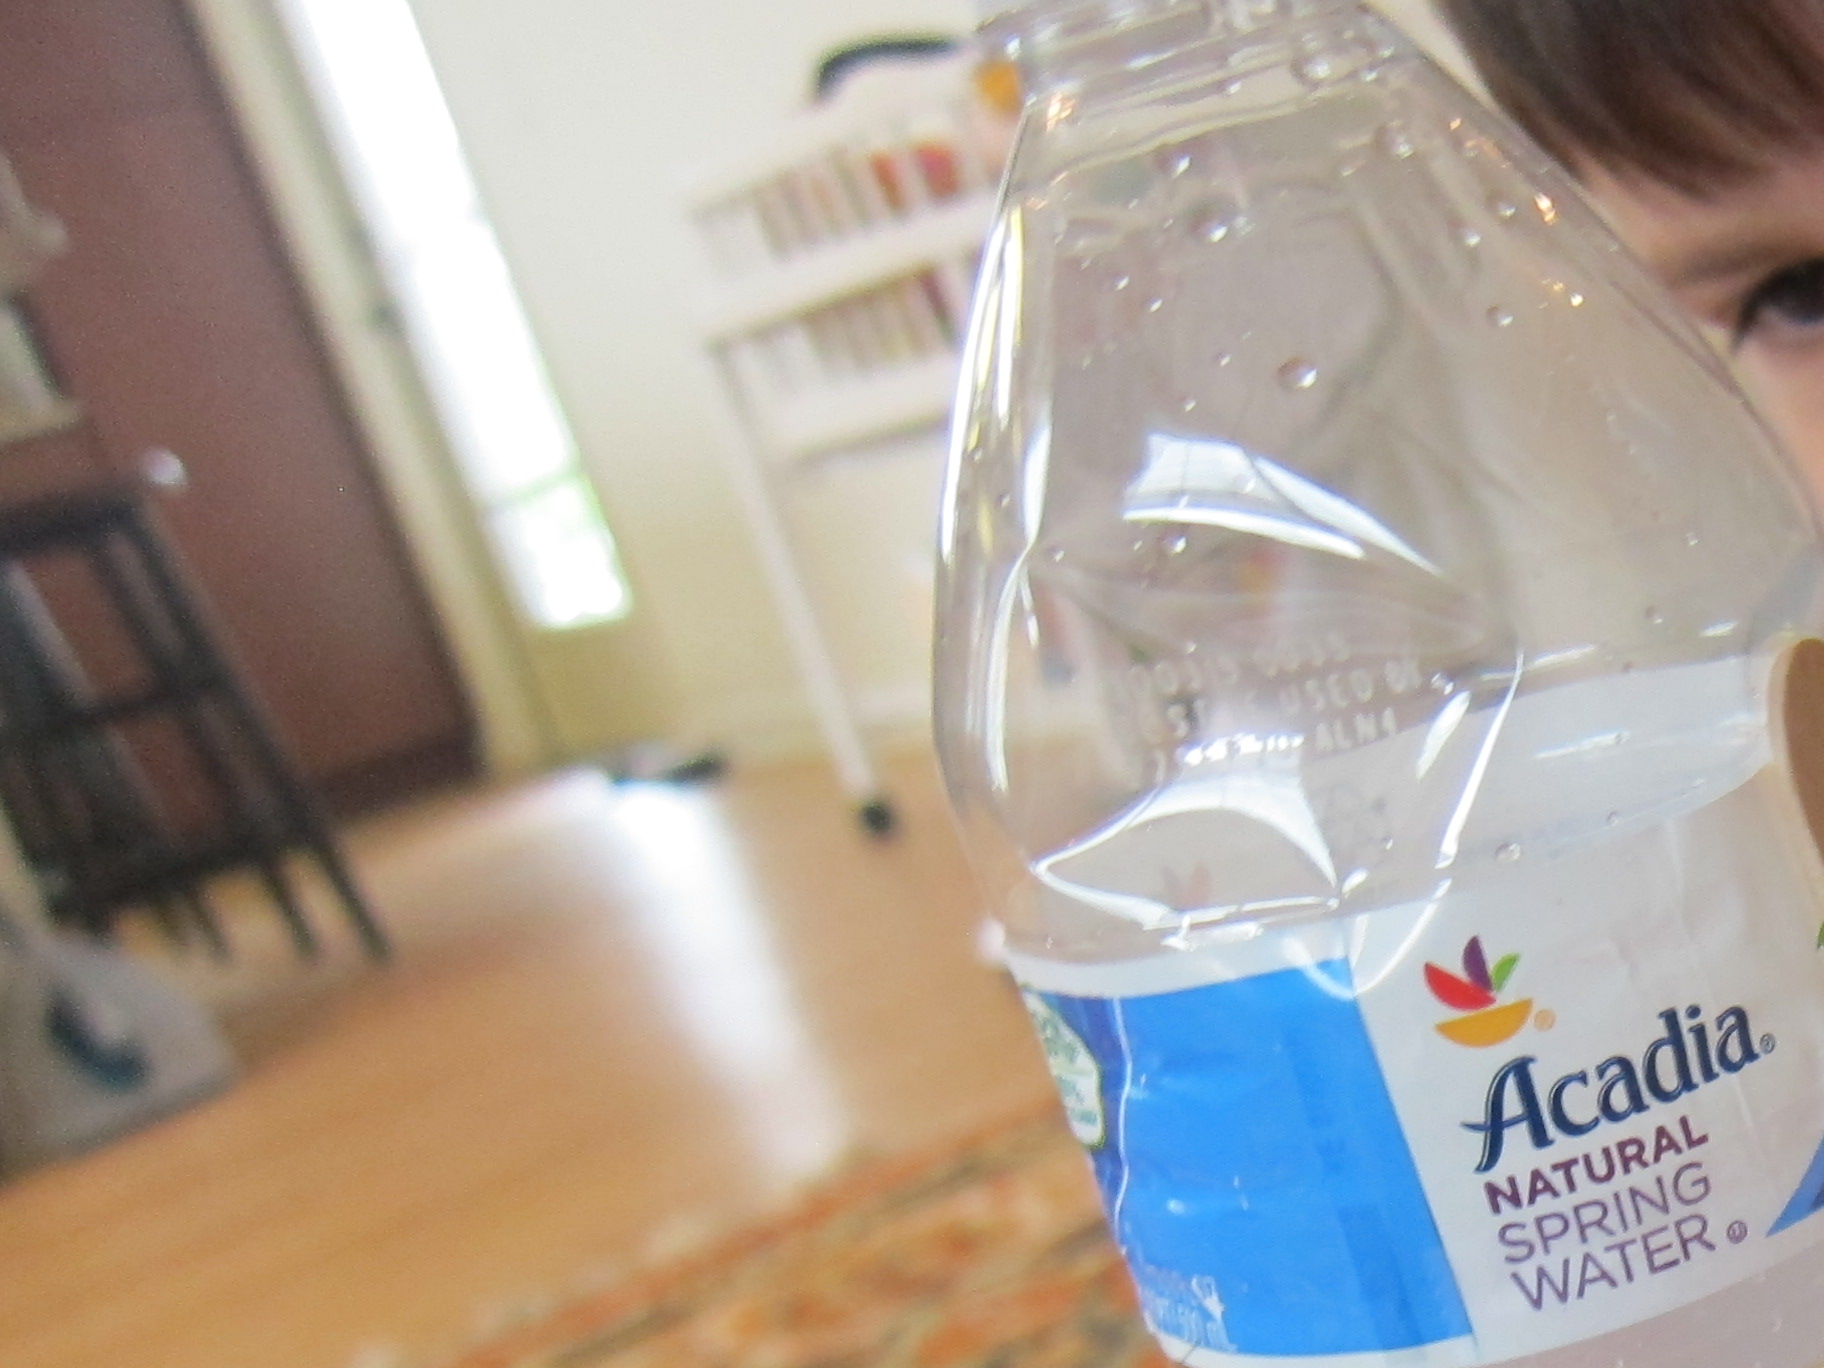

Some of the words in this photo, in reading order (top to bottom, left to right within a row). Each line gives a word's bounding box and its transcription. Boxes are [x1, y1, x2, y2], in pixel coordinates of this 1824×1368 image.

[1461, 1003, 1761, 1174] Acadia
[1483, 1115, 1710, 1215] NATURAL
[1497, 1161, 1713, 1265] SPRING
[1510, 1212, 1717, 1311] WATER
